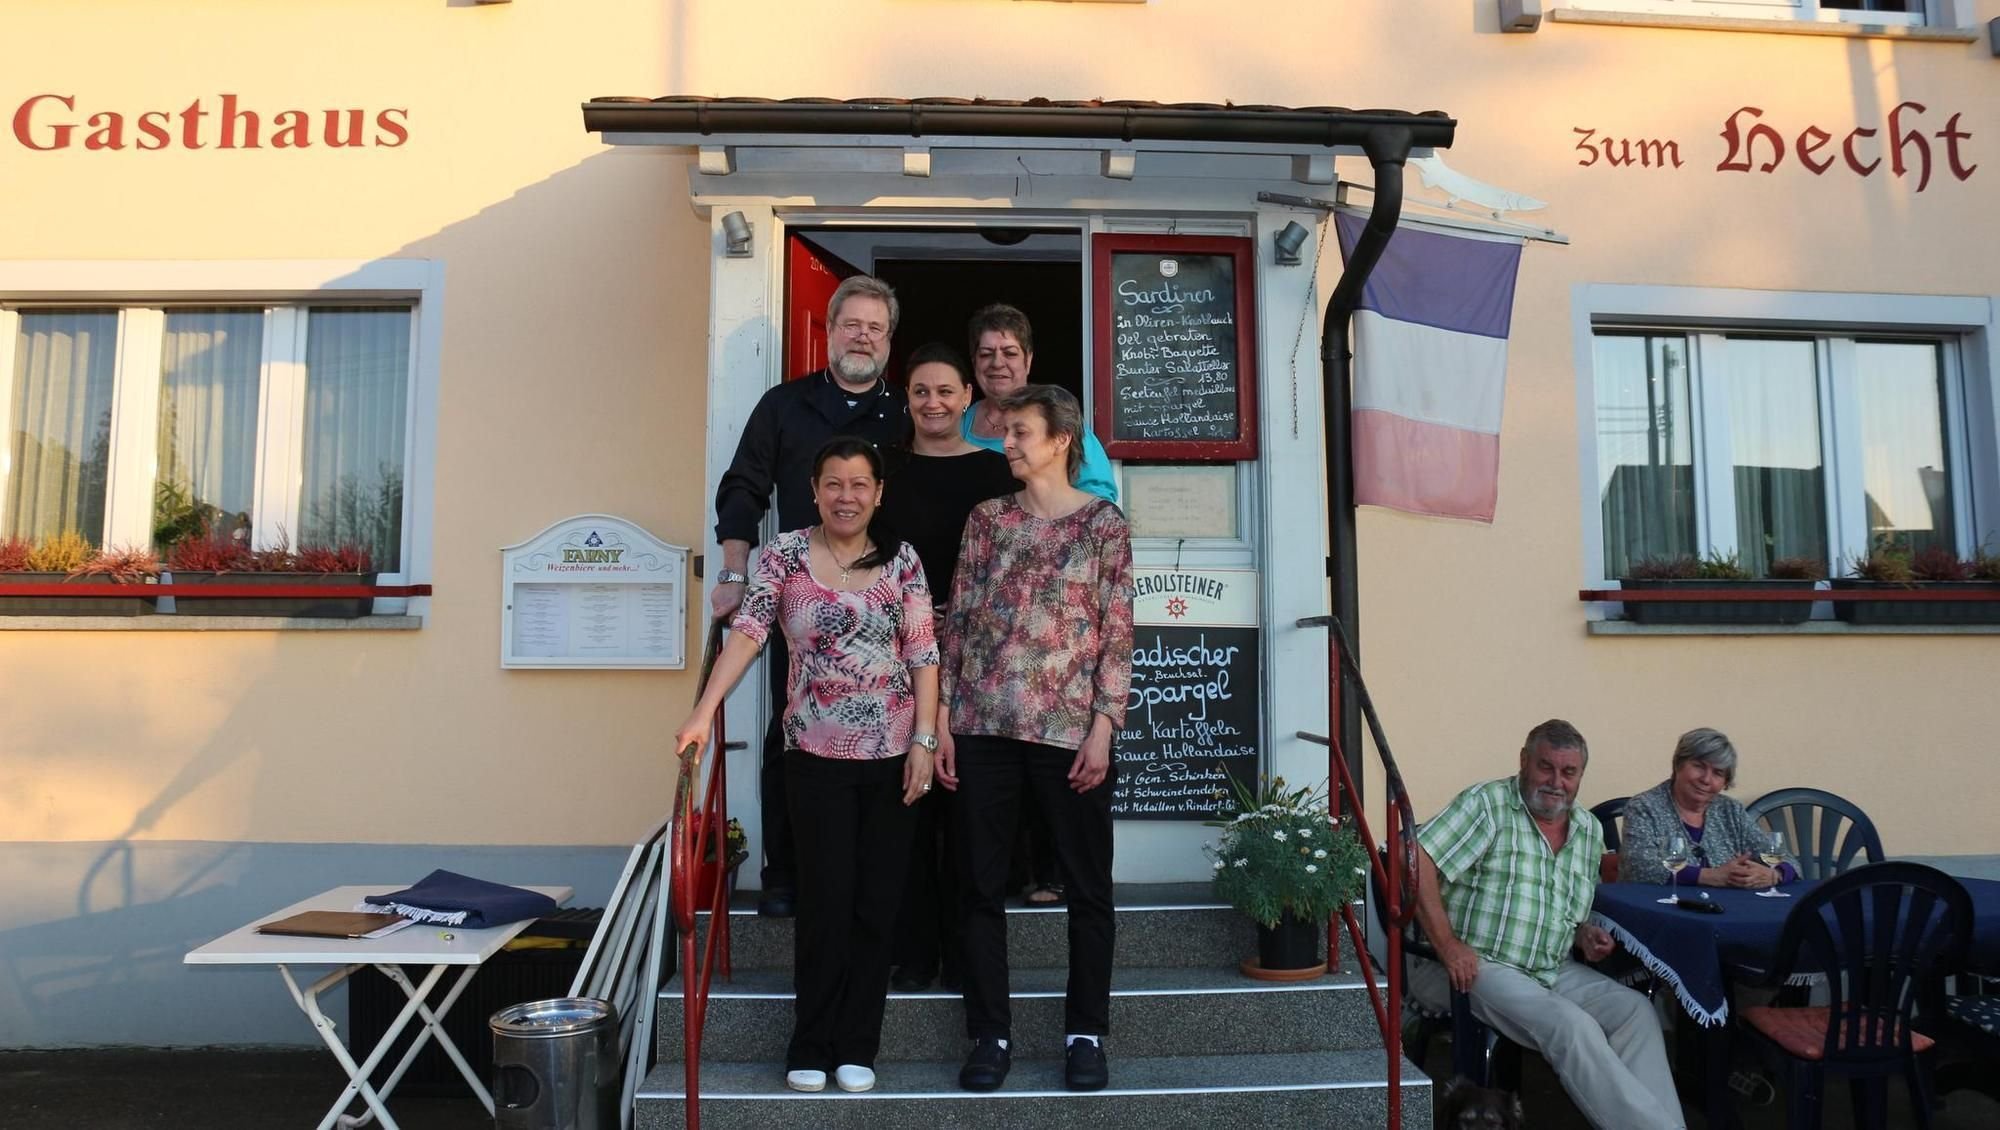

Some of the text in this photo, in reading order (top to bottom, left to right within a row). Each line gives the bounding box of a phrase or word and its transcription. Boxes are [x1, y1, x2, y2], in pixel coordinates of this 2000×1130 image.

[12, 94, 409, 150] Gasthaus
[1573, 101, 1978, 193] zum Hecht
[1119, 280, 1215, 306] Sardinen
[1117, 315, 1132, 328] in
[1118, 328, 1213, 352] Oel gebraten
[1116, 362, 1161, 380] Bunter
[1123, 402, 1145, 414] mit
[1160, 411, 1235, 425] Hollandaise
[562, 549, 624, 563] FARNY
[1131, 633, 1239, 667] adischer
[1152, 718, 1241, 746] Kartoffeln
[1163, 743, 1256, 759] Hollandaise
[1169, 768, 1226, 782] Schinken
[1110, 802, 1129, 813] mit
